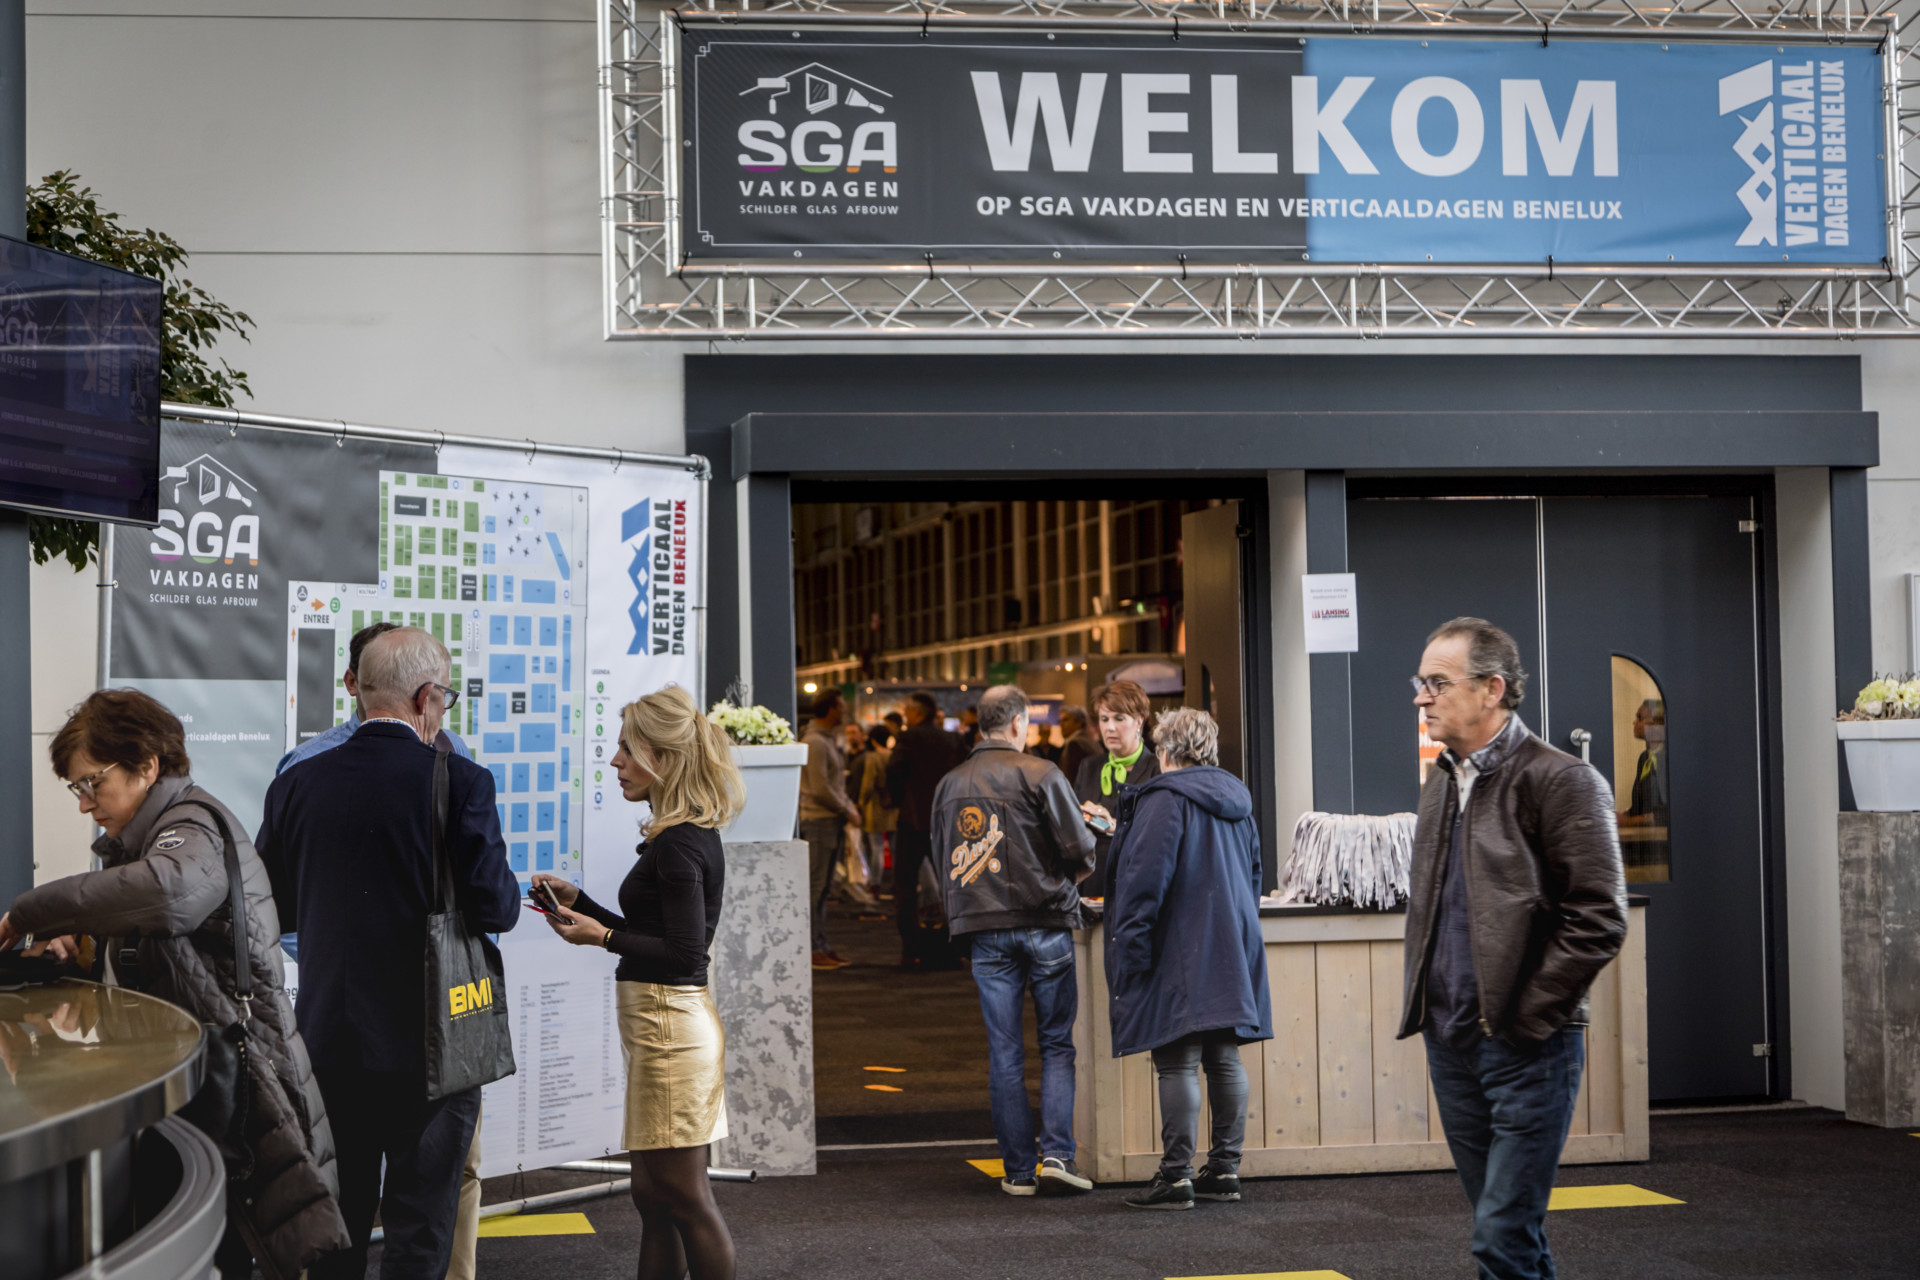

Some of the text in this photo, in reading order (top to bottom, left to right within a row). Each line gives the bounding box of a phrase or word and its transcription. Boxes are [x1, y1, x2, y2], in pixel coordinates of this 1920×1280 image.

[970, 71, 1619, 177] WELKOM
[738, 120, 897, 173] SGA
[1781, 60, 1819, 247] VERTICAAL
[1820, 60, 1849, 246] DAGEN BENELUX
[738, 180, 898, 197] VAKDAGEN
[740, 204, 899, 215] SCHILDER GLAS AFBOUW
[976, 196, 1623, 219] OP SGA VAKDAGEN EN VERTICAALDAGEN BENELUX
[0, 352, 37, 374] KDAGEN
[150, 509, 259, 566] SGA
[150, 569, 258, 589] VAKDAGEN
[652, 500, 671, 655] VERTICAAL
[672, 500, 686, 655] DAGEN BENELUX
[149, 593, 258, 606] SCHILDER GLAS AFBOUW
[303, 614, 330, 624] ENTREE
[185, 731, 270, 743] rticaaldagen Benelux
[449, 977, 493, 1015] BMI
